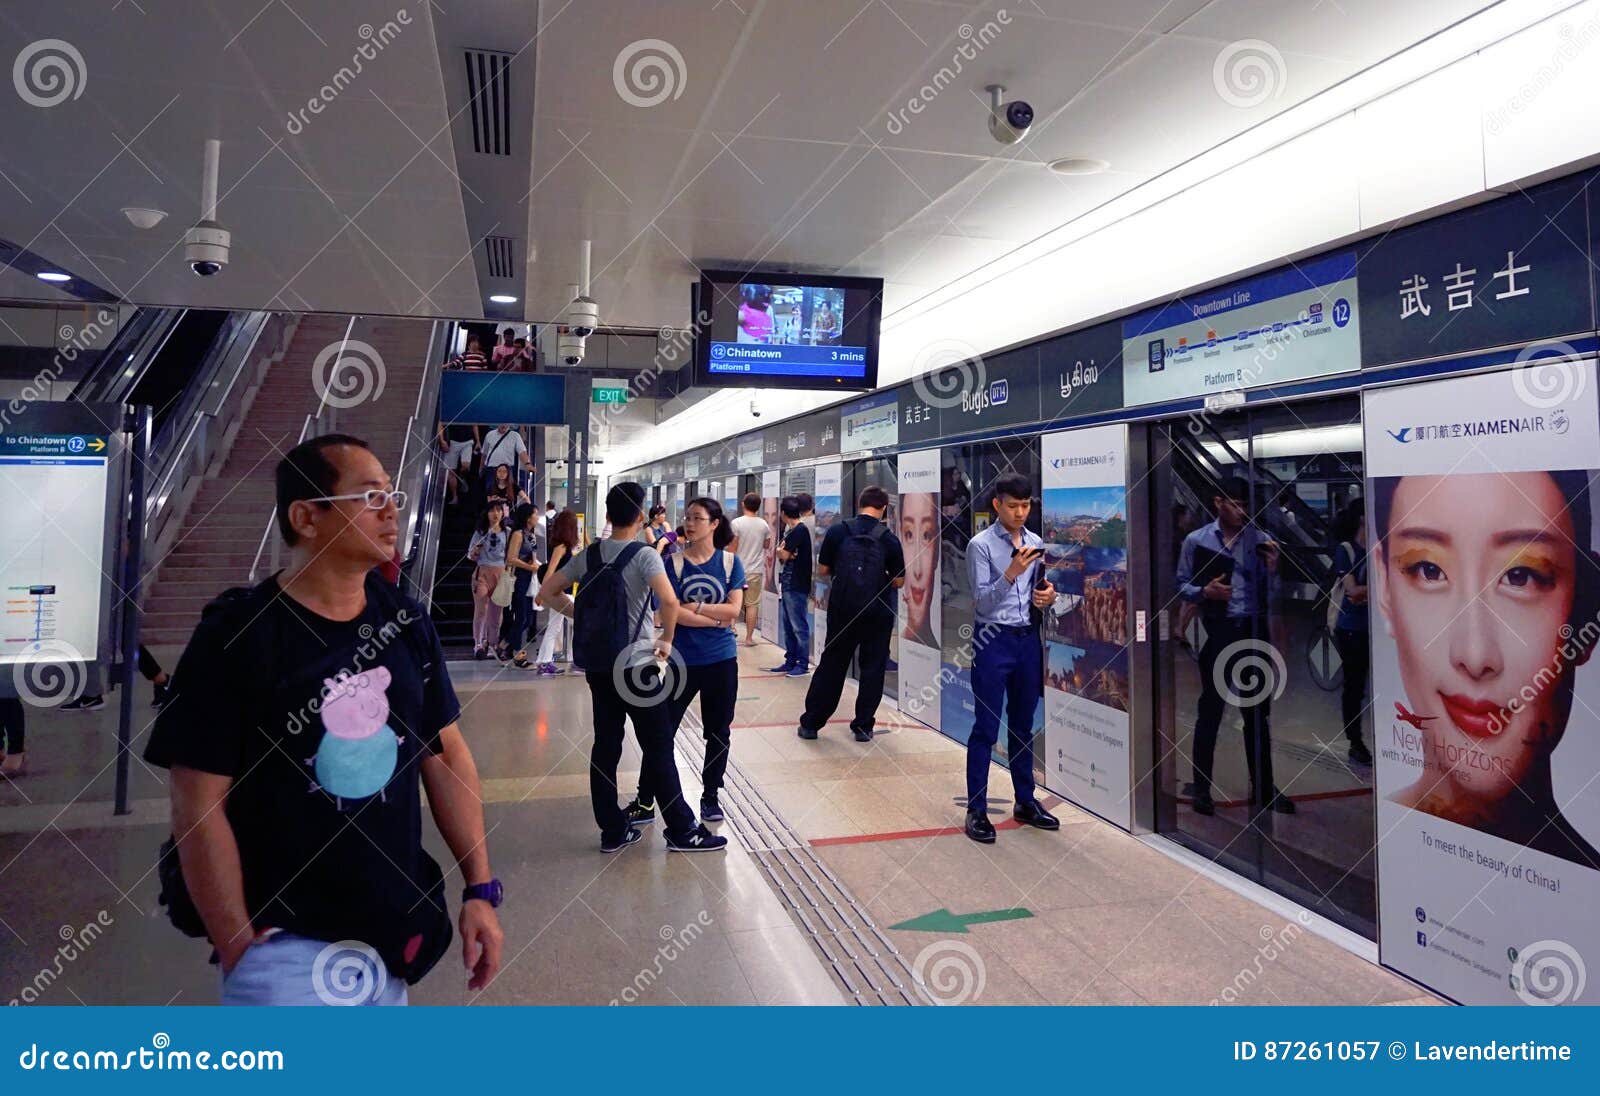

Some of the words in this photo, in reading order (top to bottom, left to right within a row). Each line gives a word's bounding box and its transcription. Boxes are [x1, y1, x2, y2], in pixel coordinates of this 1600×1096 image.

[1400, 251, 1531, 320] 武吉士
[1194, 299, 1232, 316] Downtown
[1234, 291, 1251, 304] Line
[1334, 304, 1348, 322] 12
[714, 347, 724, 356] 12
[726, 347, 782, 359] Chinatown
[831, 351, 838, 361] 3
[839, 351, 865, 361] mins
[710, 362, 743, 371] Platform
[1204, 371, 1235, 386] Platform
[1236, 369, 1243, 380] B
[600, 390, 620, 400] EXIT
[962, 384, 989, 415] Bugis
[905, 403, 931, 424] 武吉士
[1463, 416, 1545, 436] XIAMENAIR
[18, 436, 66, 445] Chinatown
[71, 440, 83, 449] 12
[1381, 748, 1400, 761] with
[1393, 724, 1427, 752] New
[1432, 737, 1512, 771] Horizons
[1422, 831, 1433, 846] To
[1434, 839, 1457, 856] meet
[1459, 845, 1474, 862] the
[1476, 850, 1510, 878] beauty
[1512, 865, 1523, 879] of
[1525, 868, 1561, 893] China!
